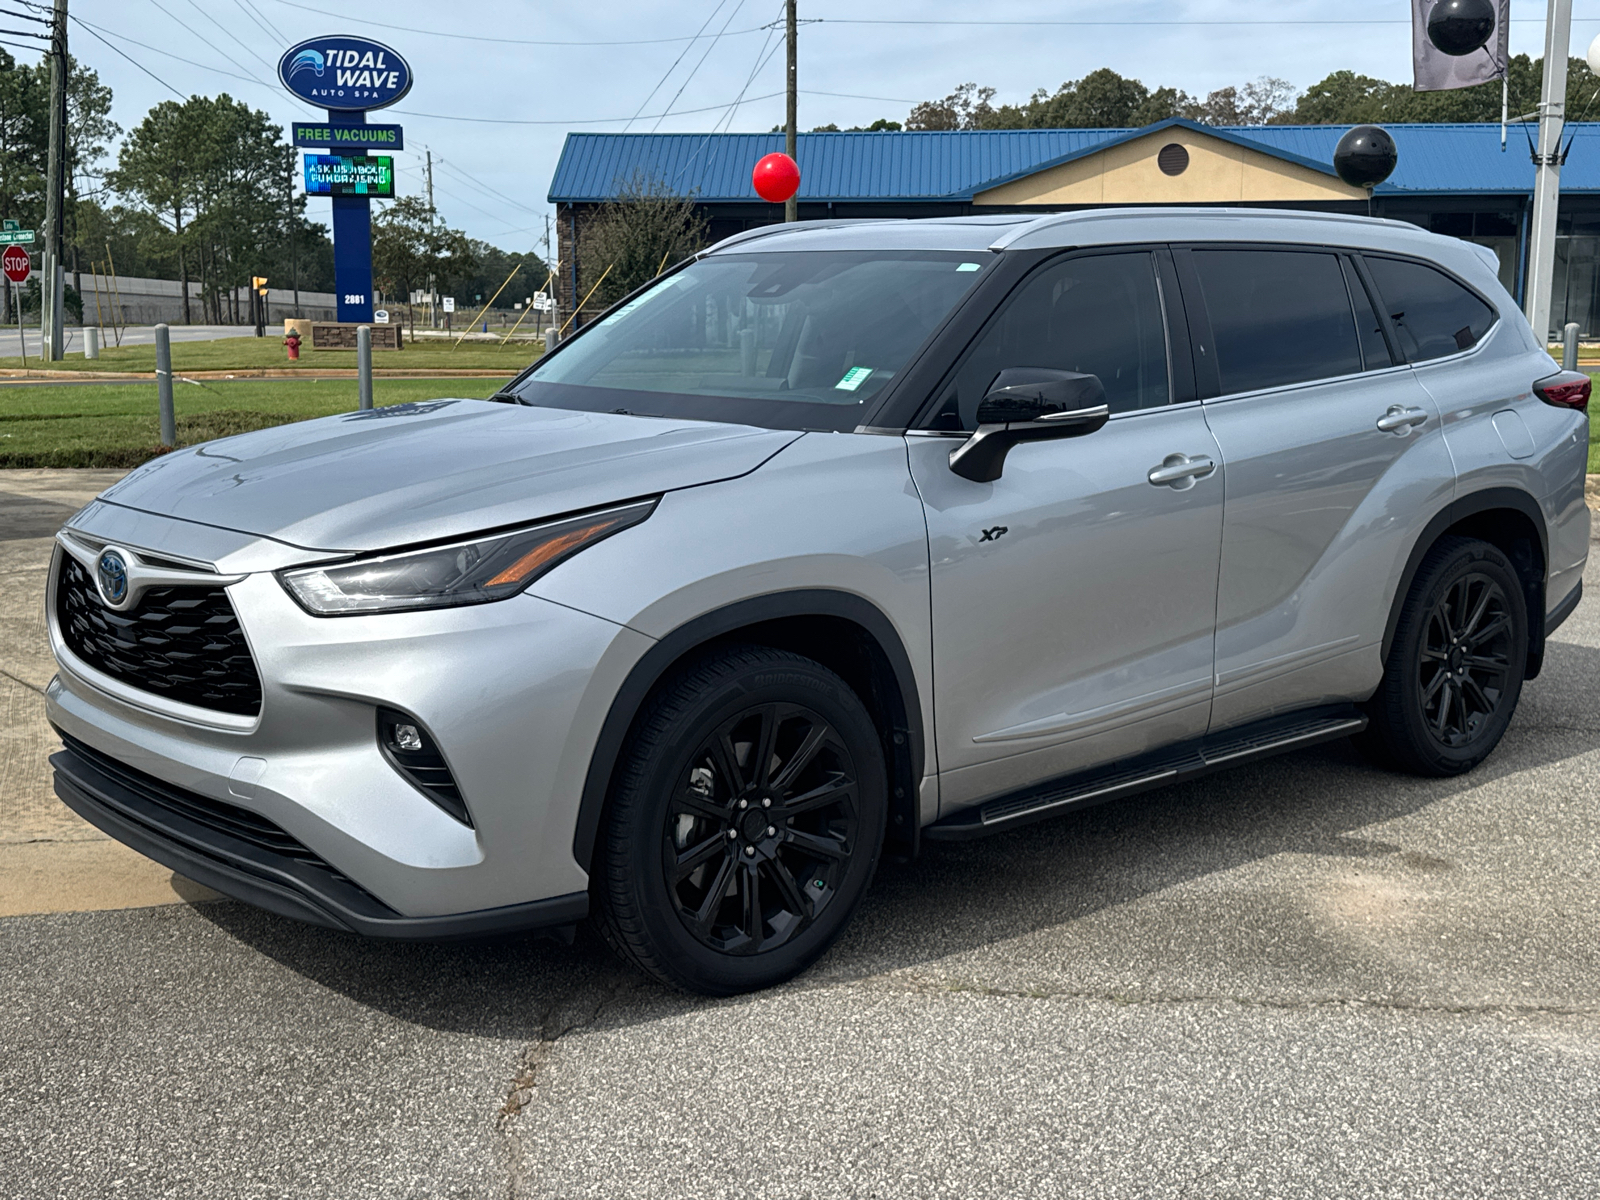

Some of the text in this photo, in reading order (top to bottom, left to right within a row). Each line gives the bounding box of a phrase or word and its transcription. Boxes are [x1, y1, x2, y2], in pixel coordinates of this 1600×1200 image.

[325, 49, 387, 69] TIDAL
[336, 69, 400, 89] WAVE
[311, 88, 379, 99] AUTO SPA
[297, 128, 396, 143] FREE VACUUMS
[309, 164, 331, 173] ASK
[5, 257, 28, 271] STOP
